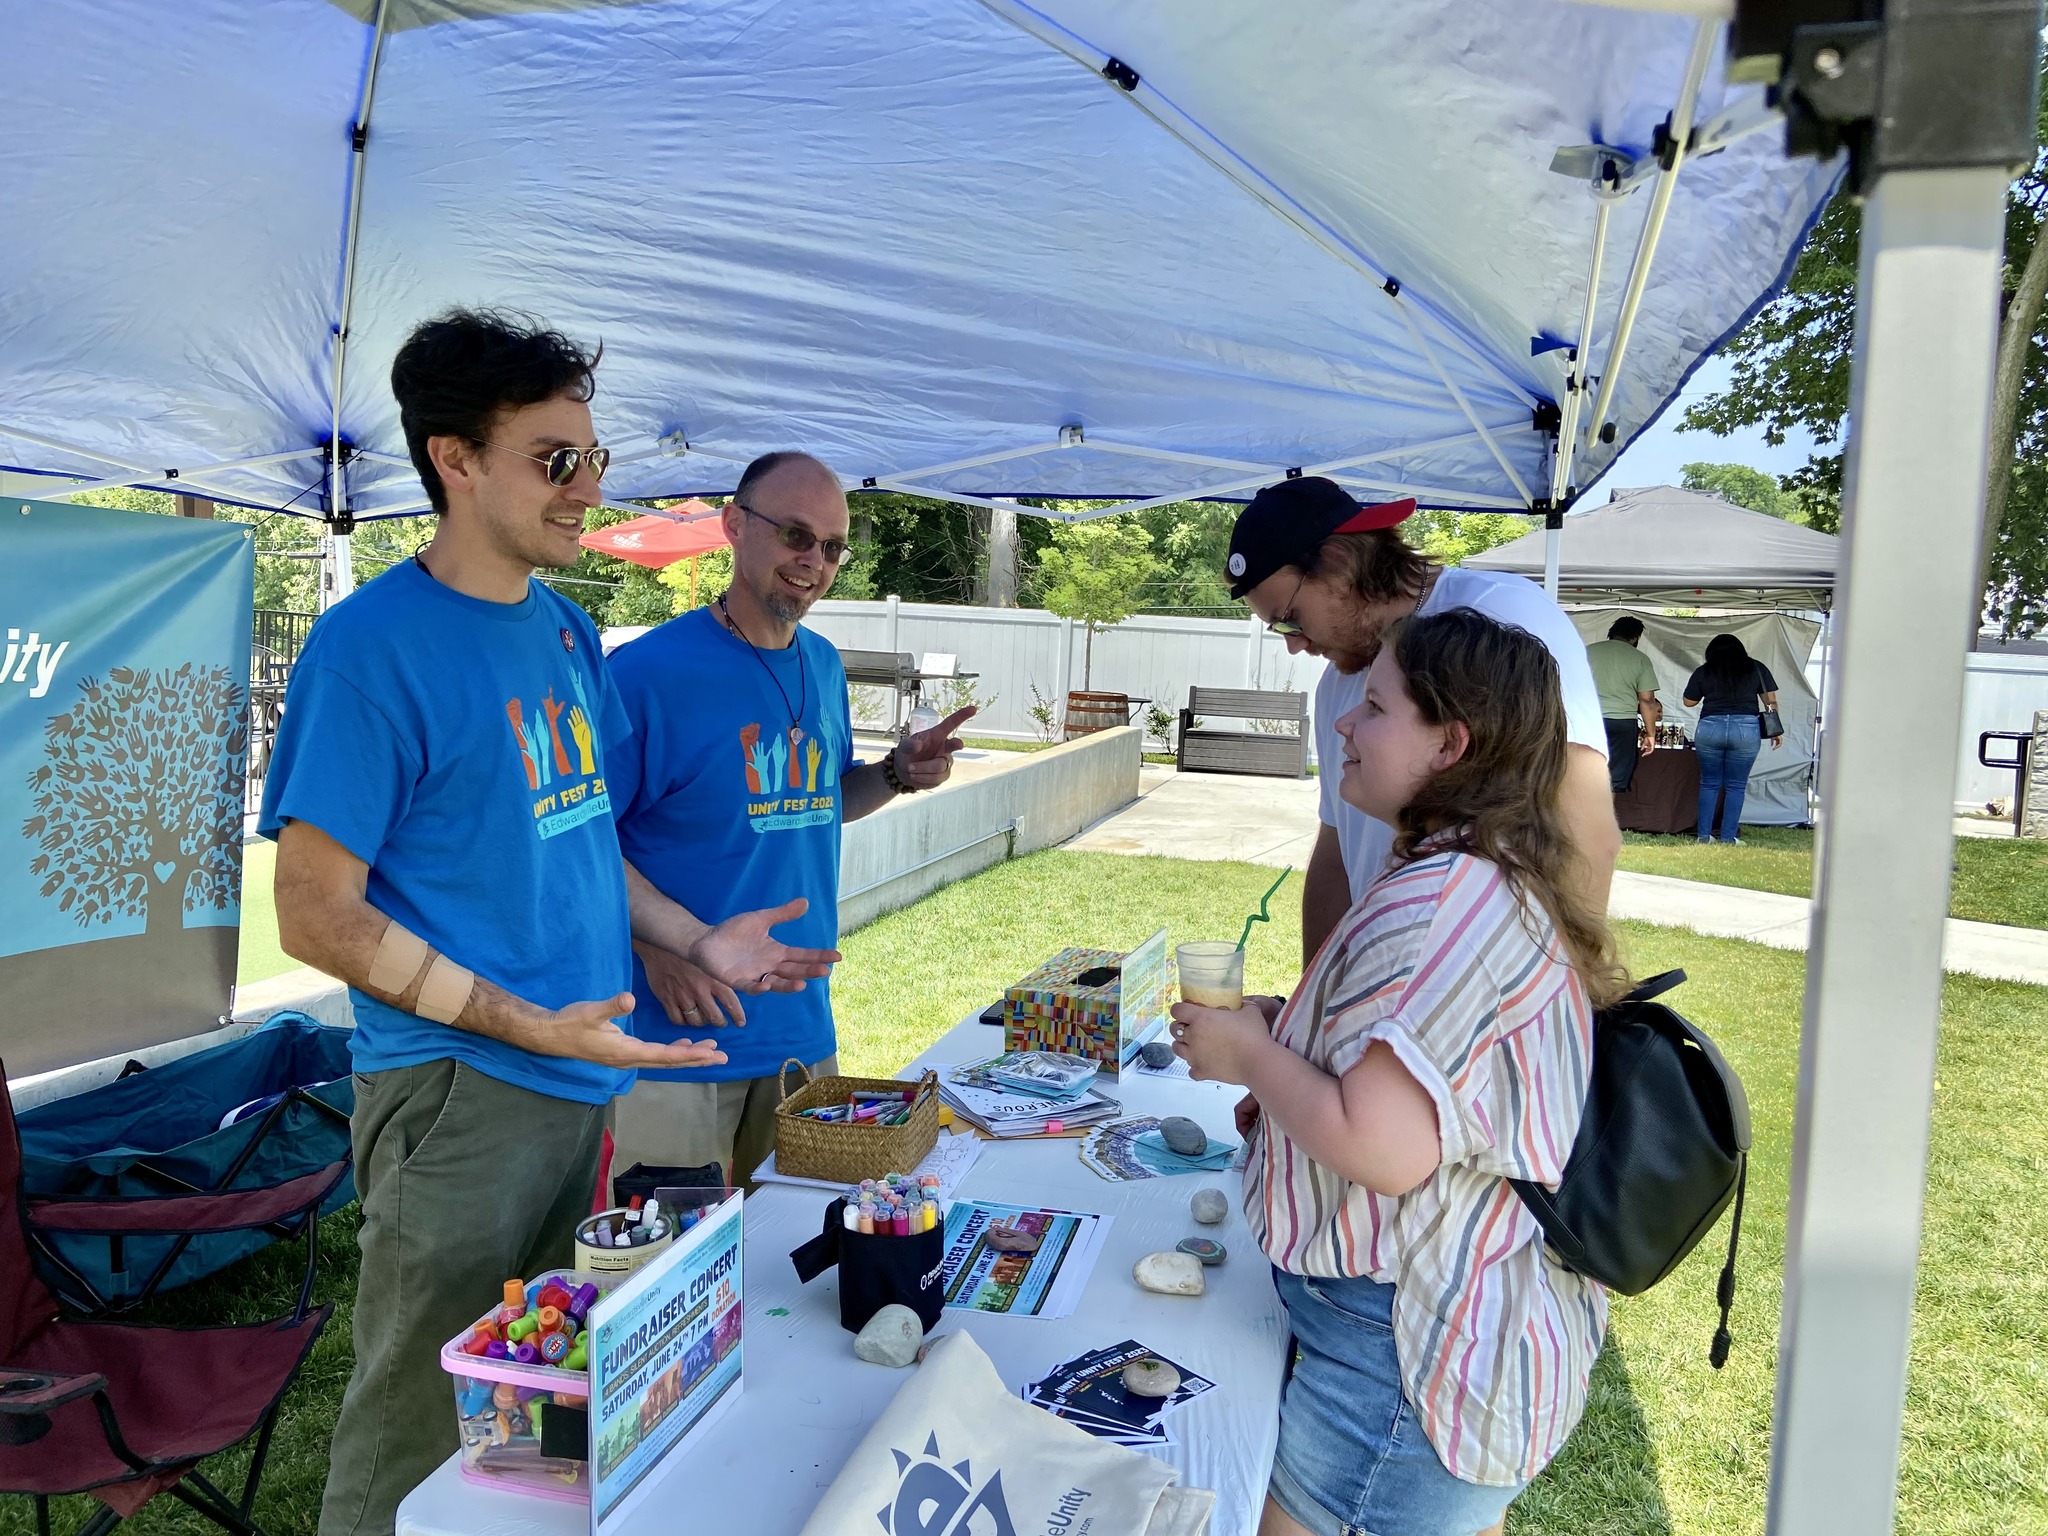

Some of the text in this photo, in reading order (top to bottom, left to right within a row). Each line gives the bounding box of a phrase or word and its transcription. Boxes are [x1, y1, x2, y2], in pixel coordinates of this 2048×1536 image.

[560, 782, 588, 808] FEST
[783, 798, 809, 813] FEST
[956, 1208, 990, 1245] CONCERT
[715, 1277, 730, 1306] $10
[956, 1274, 985, 1305] SATURDAY,
[601, 1289, 687, 1386] FUNDRAISER
[690, 1242, 738, 1304] CONCERT
[711, 1291, 737, 1322] DONATION
[602, 1367, 649, 1423] SATURDAY,
[651, 1348, 670, 1377] JUNE
[690, 1322, 695, 1342] 7
[697, 1311, 708, 1334] PM
[1076, 1363, 1104, 1377] UNITY
[1103, 1355, 1126, 1367] FEST
[1047, 1487, 1092, 1536] eUnity
